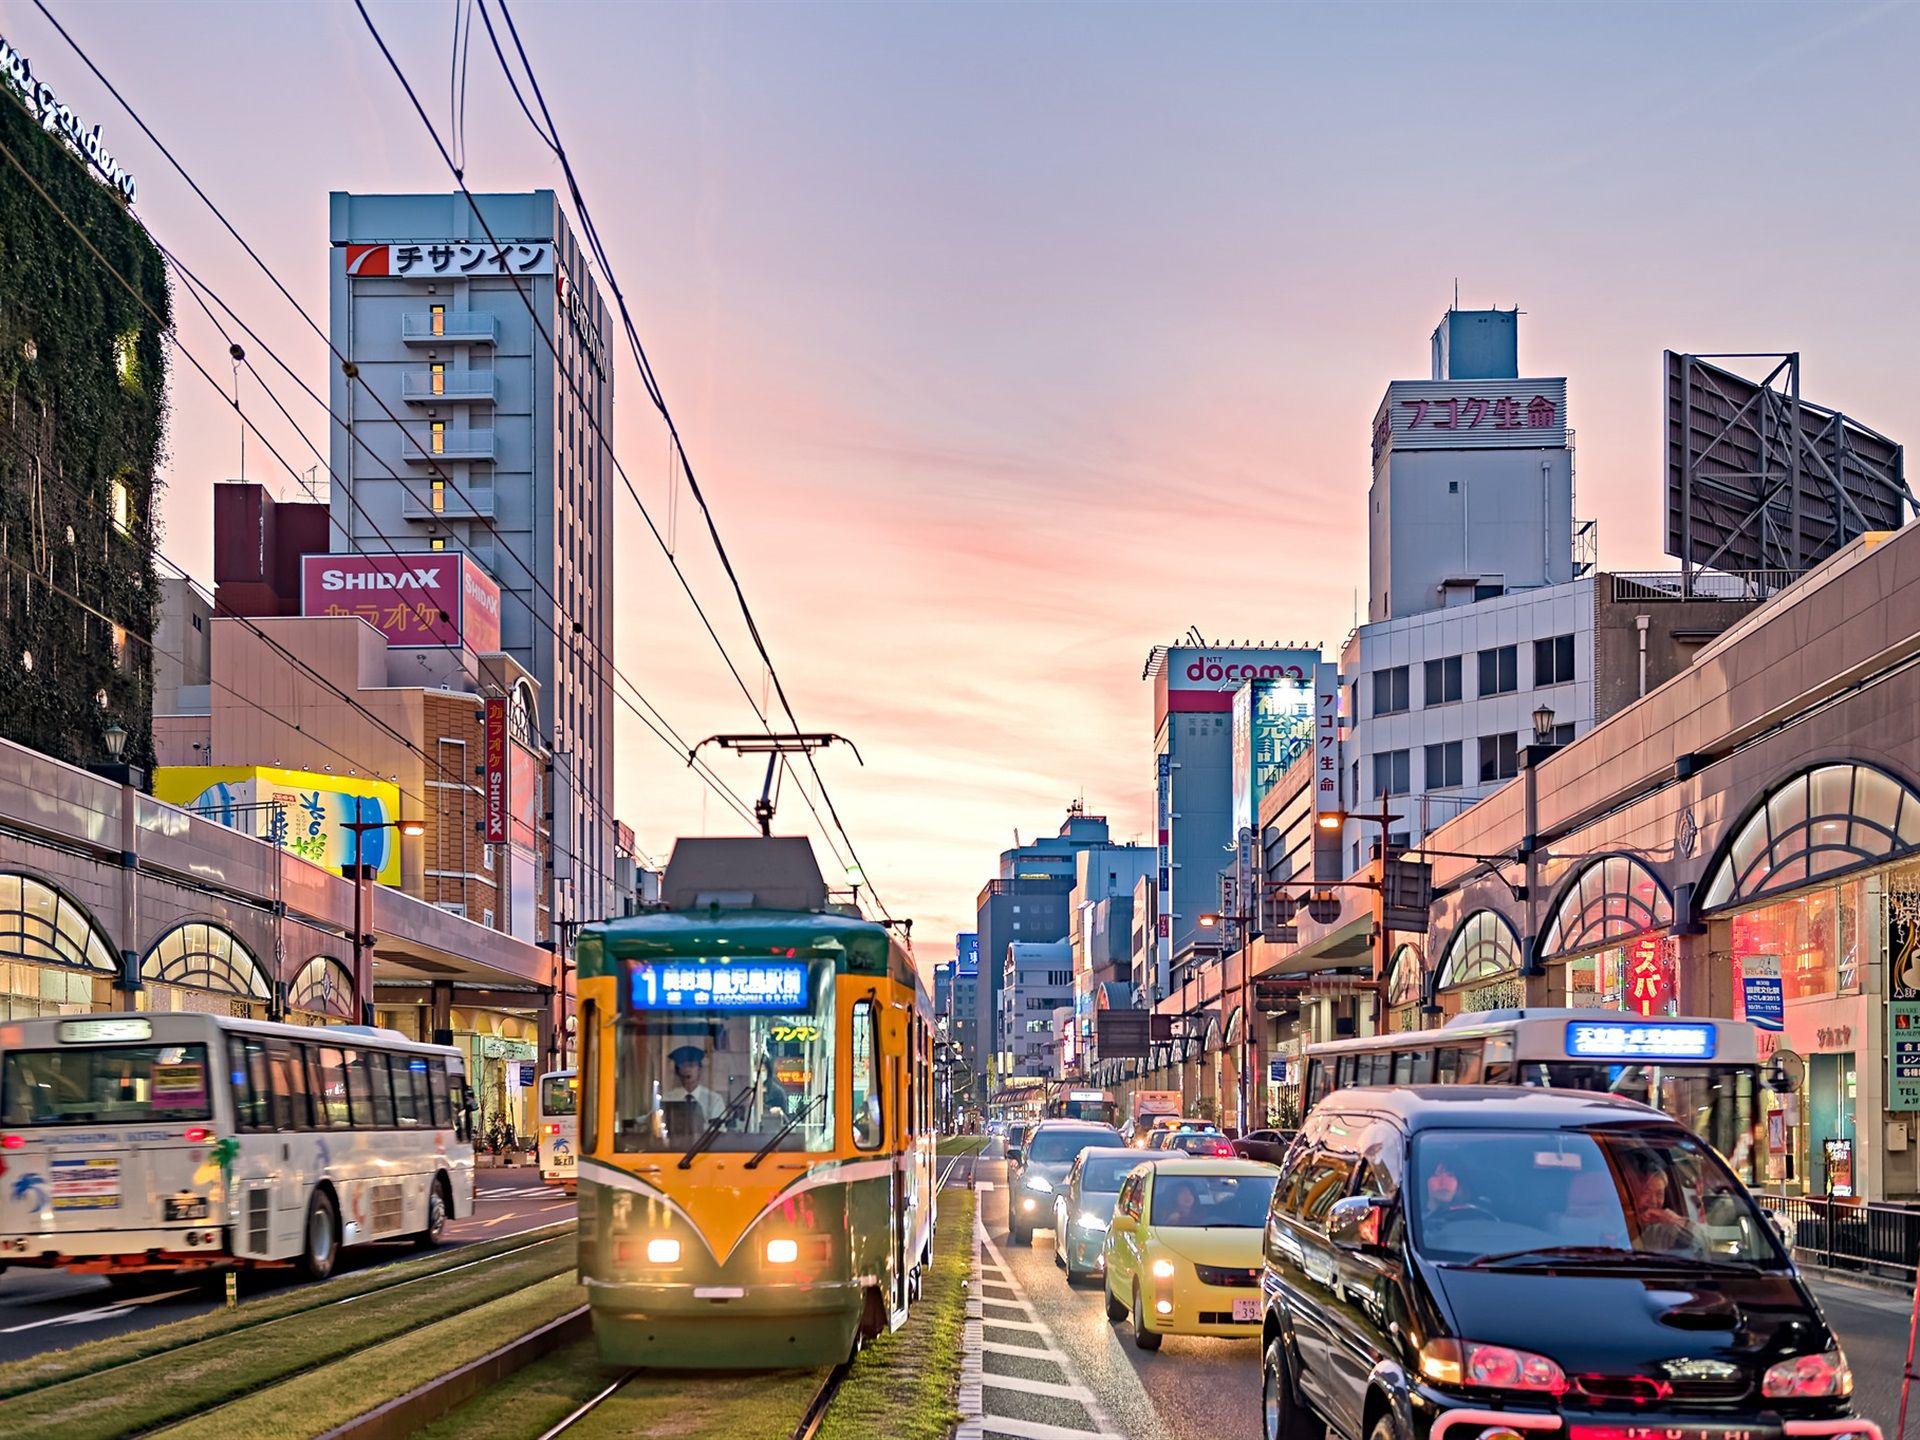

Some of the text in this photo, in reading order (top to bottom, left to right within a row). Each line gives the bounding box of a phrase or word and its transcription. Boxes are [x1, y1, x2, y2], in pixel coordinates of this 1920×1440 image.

[396, 245, 545, 272] チサンイン
[1401, 395, 1556, 430] フコク生命
[322, 569, 440, 590] SHIDAX
[465, 573, 498, 618] SHIDAX
[1186, 656, 1303, 682] docomo
[1319, 694, 1335, 792] フコク生命
[490, 771, 503, 835] SHIDAX
[641, 968, 657, 1005] 1
